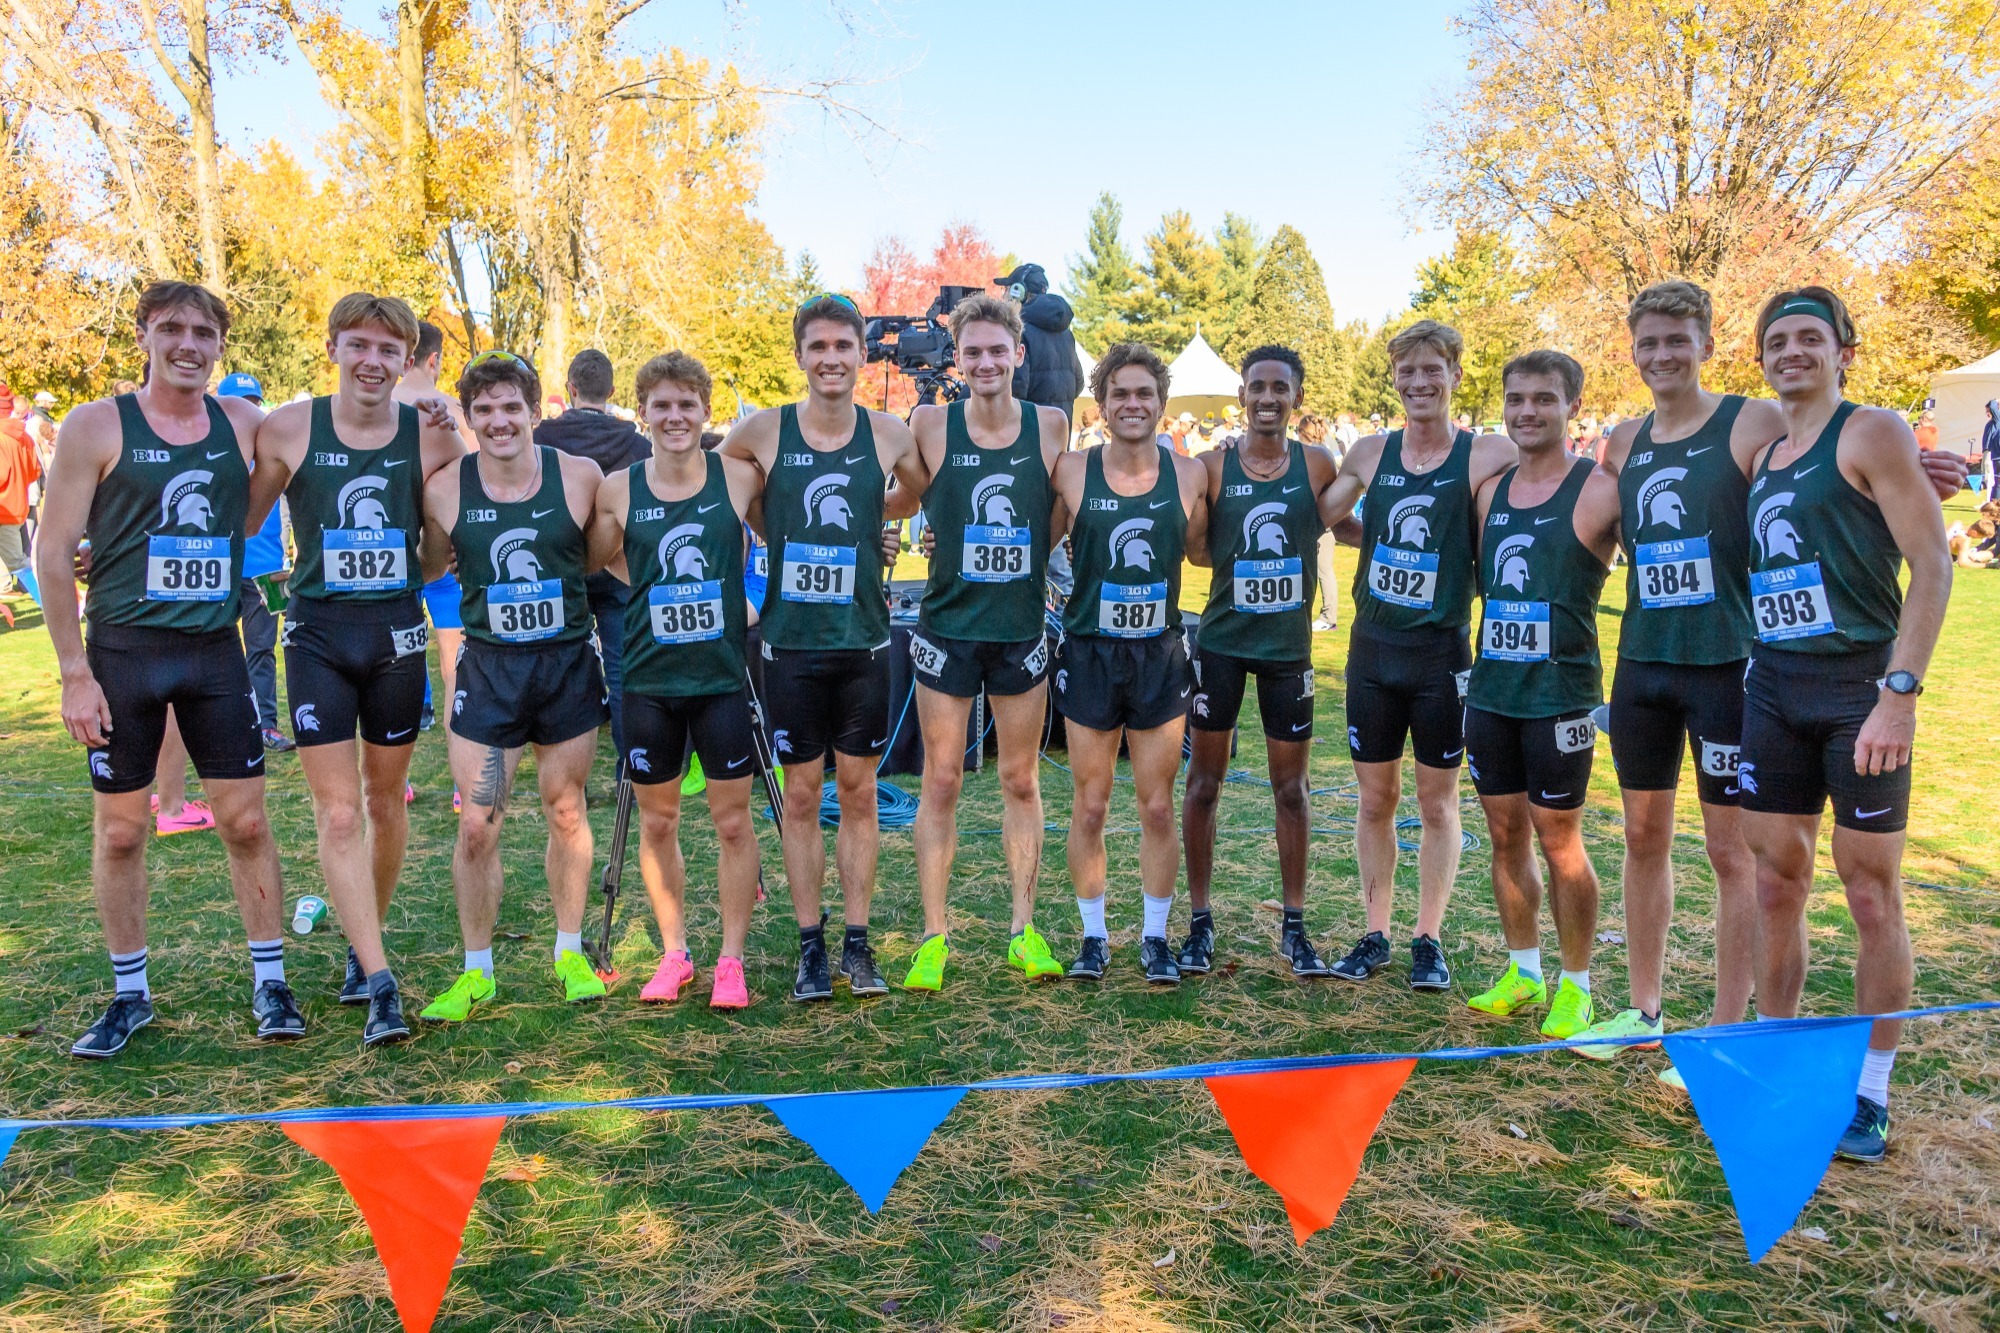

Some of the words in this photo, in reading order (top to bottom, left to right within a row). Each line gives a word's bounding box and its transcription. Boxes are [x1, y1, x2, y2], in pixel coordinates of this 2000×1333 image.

[338, 550, 395, 579] 382
[974, 545, 1022, 573] 383
[163, 559, 221, 589] 389
[796, 564, 843, 593] 391
[1377, 565, 1425, 598] 392
[1646, 561, 1700, 596] 384
[1245, 577, 1292, 604] 390
[501, 601, 554, 632] 380
[662, 602, 715, 633] 385
[1112, 602, 1156, 628] 387
[1758, 590, 1816, 629] 393
[1491, 621, 1538, 651] 394
[912, 642, 938, 669] 383
[1031, 639, 1047, 671] 38
[1566, 722, 1595, 747] 394
[1711, 751, 1739, 771] 38
